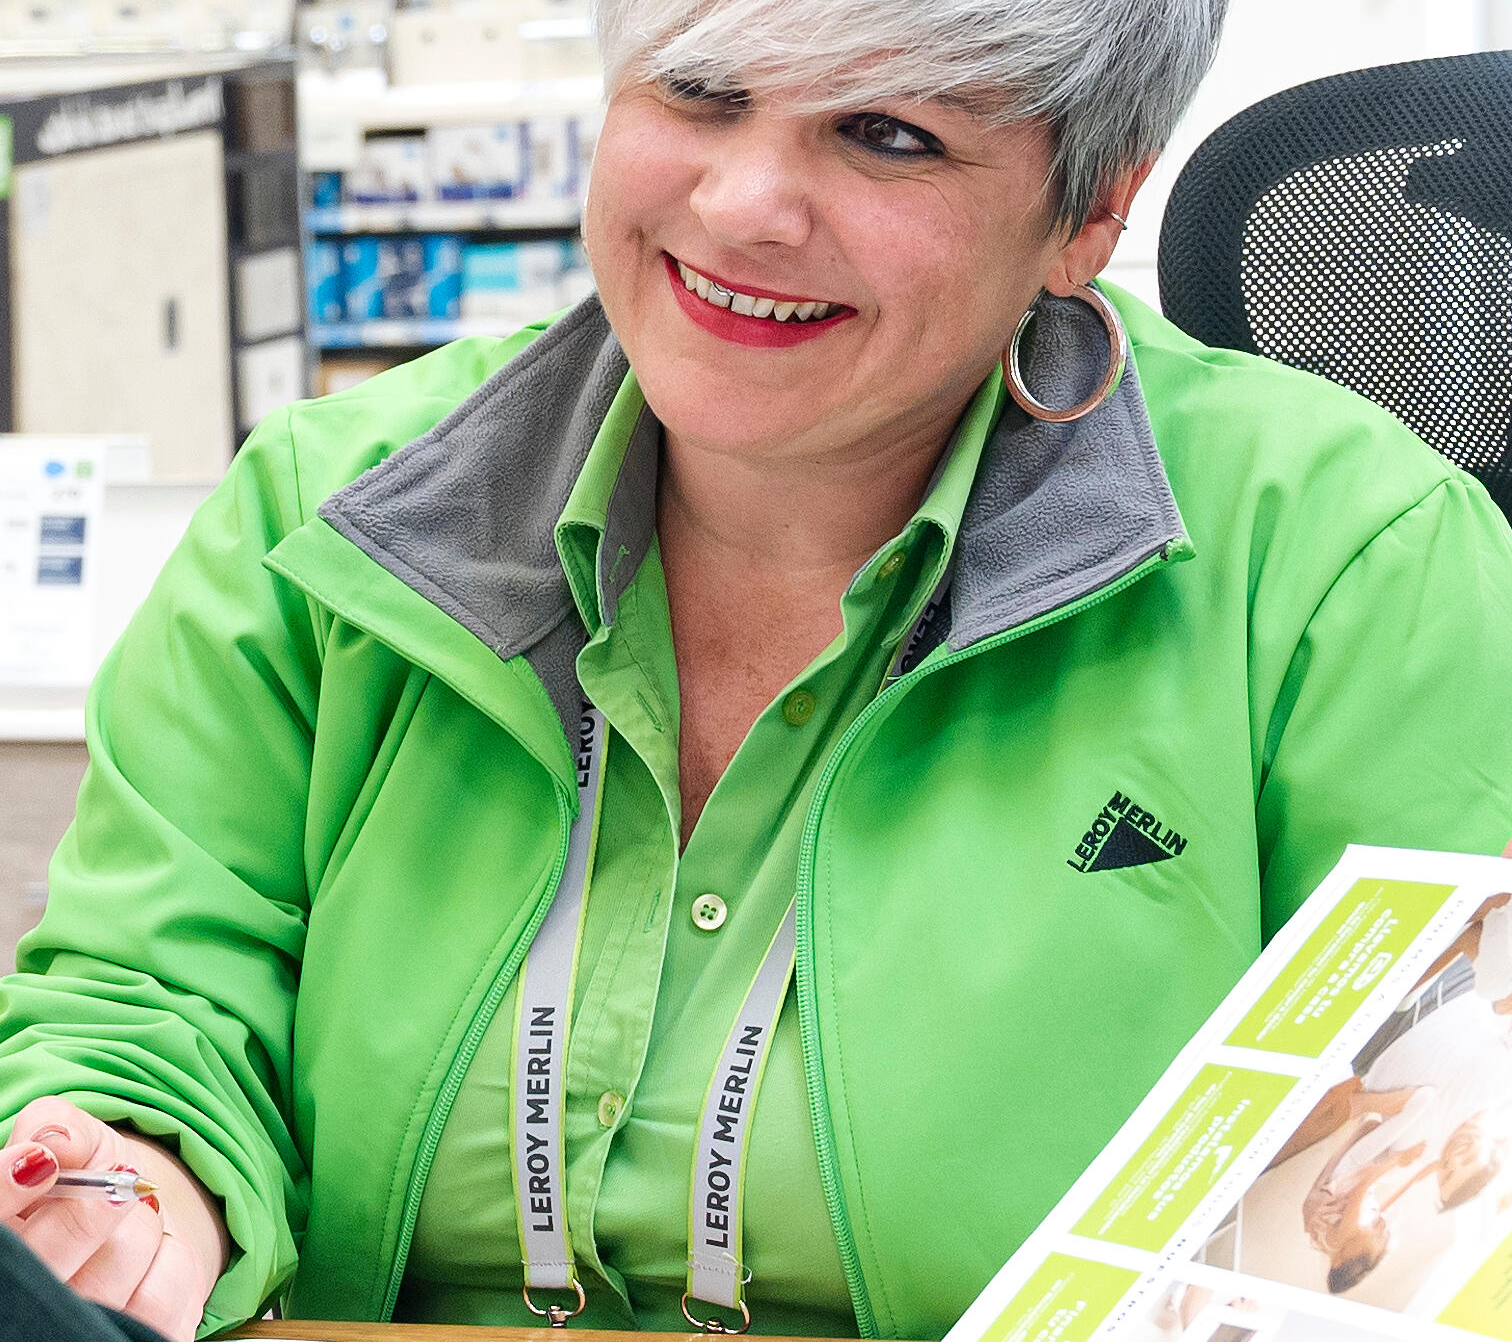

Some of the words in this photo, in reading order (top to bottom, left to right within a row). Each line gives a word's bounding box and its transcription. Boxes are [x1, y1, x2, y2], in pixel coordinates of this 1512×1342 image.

[1066, 806, 1116, 873] LEROY
[1107, 790, 1188, 856] MERLIN
[1326, 918, 1400, 996] Llevamos
[1335, 908, 1395, 969] compra
[1291, 985, 1331, 1024] casa
[1309, 999, 1334, 1018] tu
[526, 1006, 556, 1124] MERLIN
[712, 1025, 763, 1143] MERLIN
[526, 1132, 554, 1232] LEROY
[1149, 1115, 1226, 1200] productos
[1168, 1098, 1252, 1191] Instalamos
[705, 1148, 733, 1249] LEROY
[1144, 1193, 1175, 1221] tus
[1045, 1307, 1068, 1327] tu
